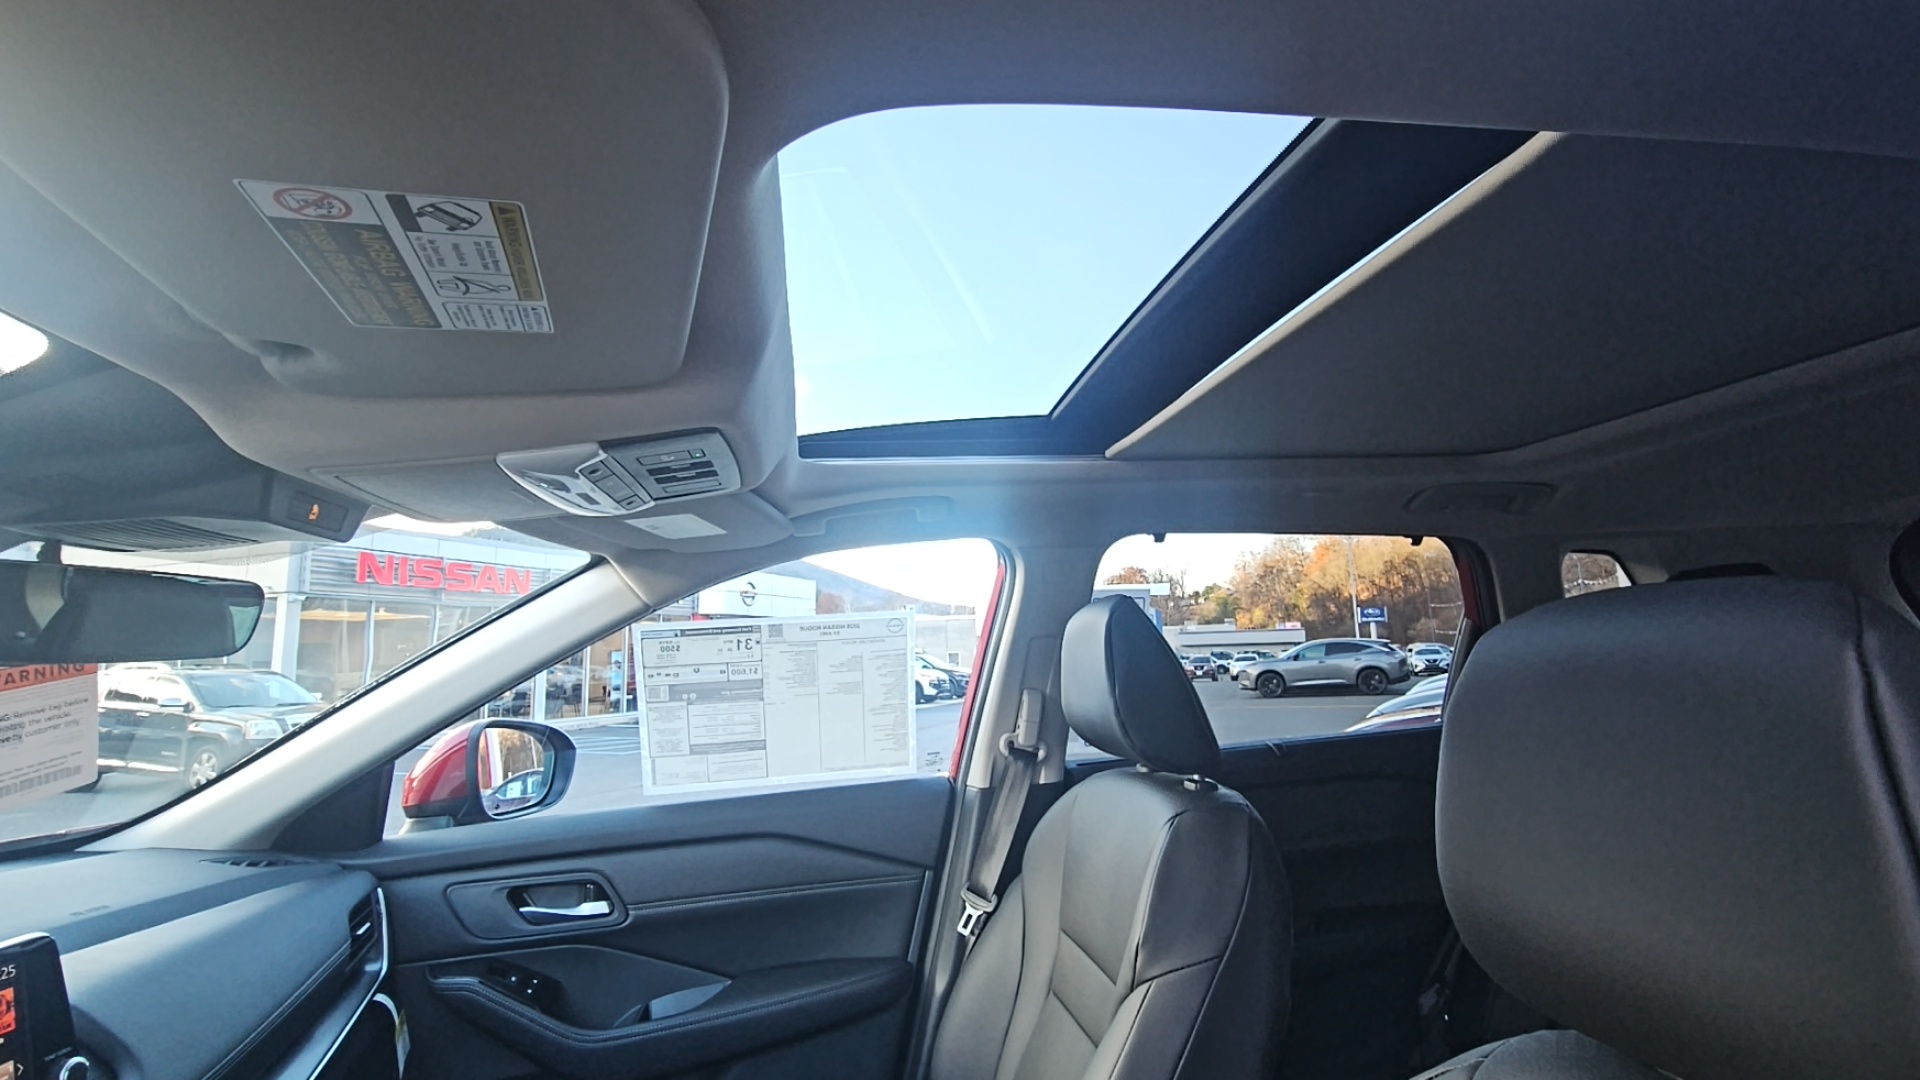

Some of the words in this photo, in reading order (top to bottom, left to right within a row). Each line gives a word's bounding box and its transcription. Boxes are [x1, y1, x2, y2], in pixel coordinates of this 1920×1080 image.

[352, 228, 407, 277] AIRBAG
[387, 281, 435, 325] WARNING
[356, 551, 531, 595] NISSAN
[0, 662, 85, 686] ARNING
